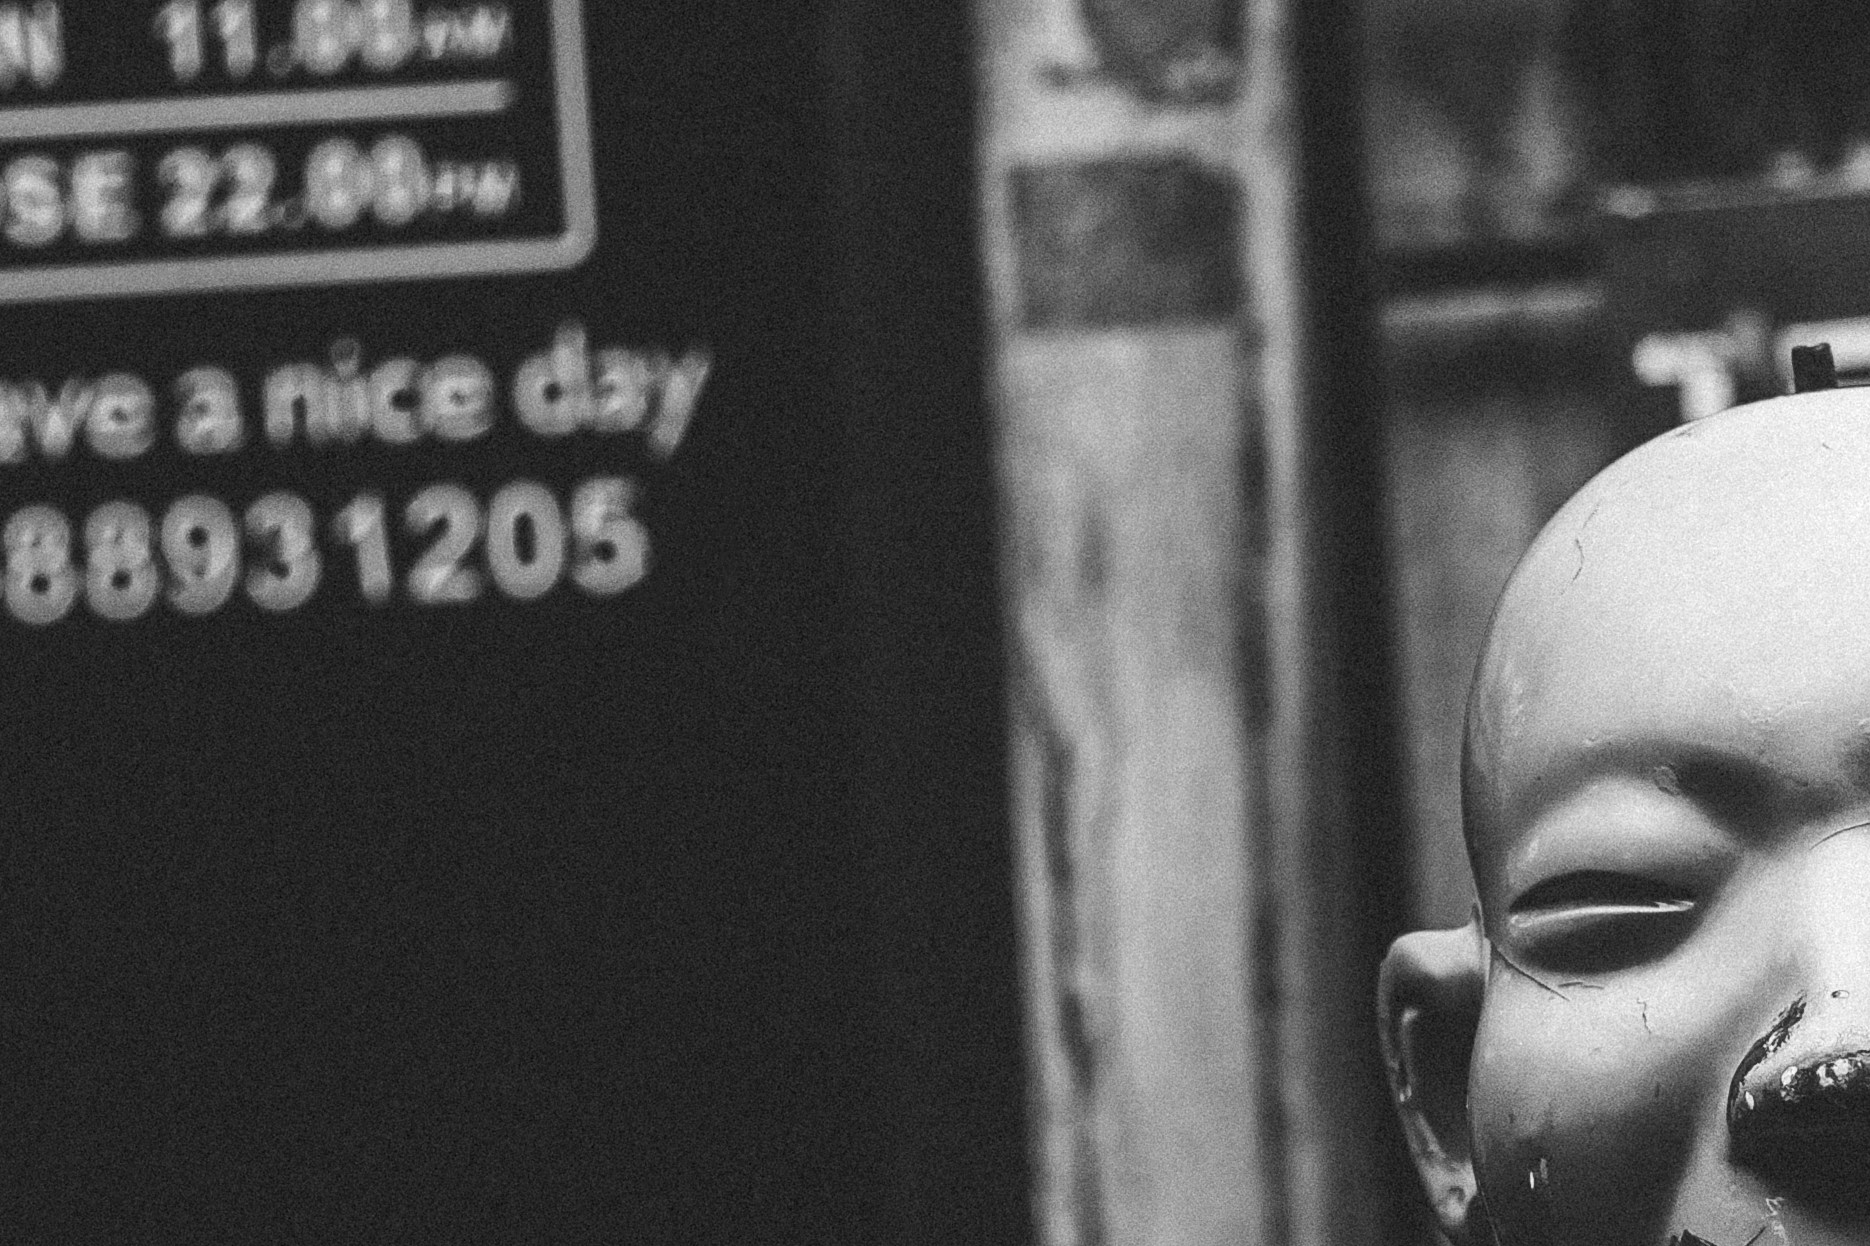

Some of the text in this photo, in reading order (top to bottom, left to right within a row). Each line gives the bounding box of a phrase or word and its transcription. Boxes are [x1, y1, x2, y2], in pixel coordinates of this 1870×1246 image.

[174, 365, 244, 456] a
[261, 337, 496, 447] nice
[512, 321, 712, 460] day
[2, 475, 651, 625] 88931205
